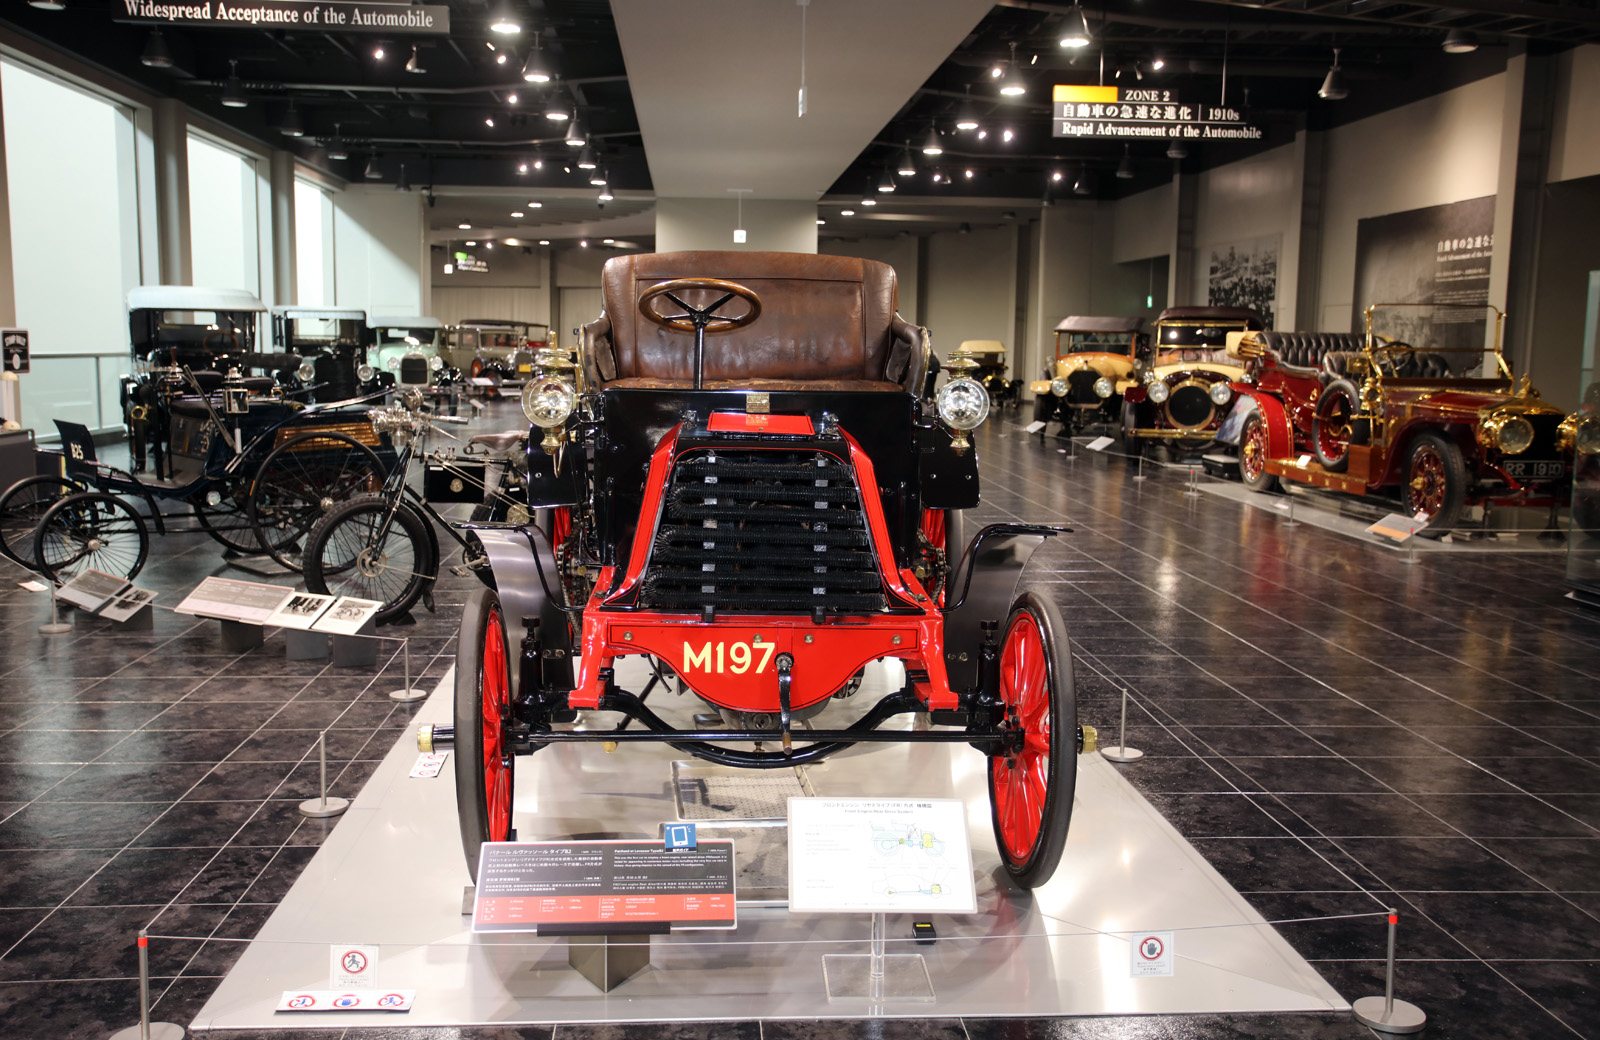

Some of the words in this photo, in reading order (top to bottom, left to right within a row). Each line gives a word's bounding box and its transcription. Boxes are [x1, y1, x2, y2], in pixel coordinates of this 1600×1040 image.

[125, 0, 211, 21] Widespread
[216, 2, 299, 24] Acceptance
[304, 6, 321, 23] of
[323, 8, 346, 25] the
[351, 8, 434, 28] Automobile
[1125, 90, 1159, 102] ZONE
[1163, 90, 1171, 102] 2
[1062, 103, 1192, 120] 自動車の急速な進化
[1208, 107, 1240, 121] 1910s
[1062, 121, 1094, 137] Rapid
[1096, 122, 1167, 137] Advancement
[1169, 124, 1181, 137] of
[1183, 125, 1200, 138] the
[1202, 125, 1262, 139] Automobile
[1505, 463, 1526, 476] RR
[683, 640, 776, 674] M197
